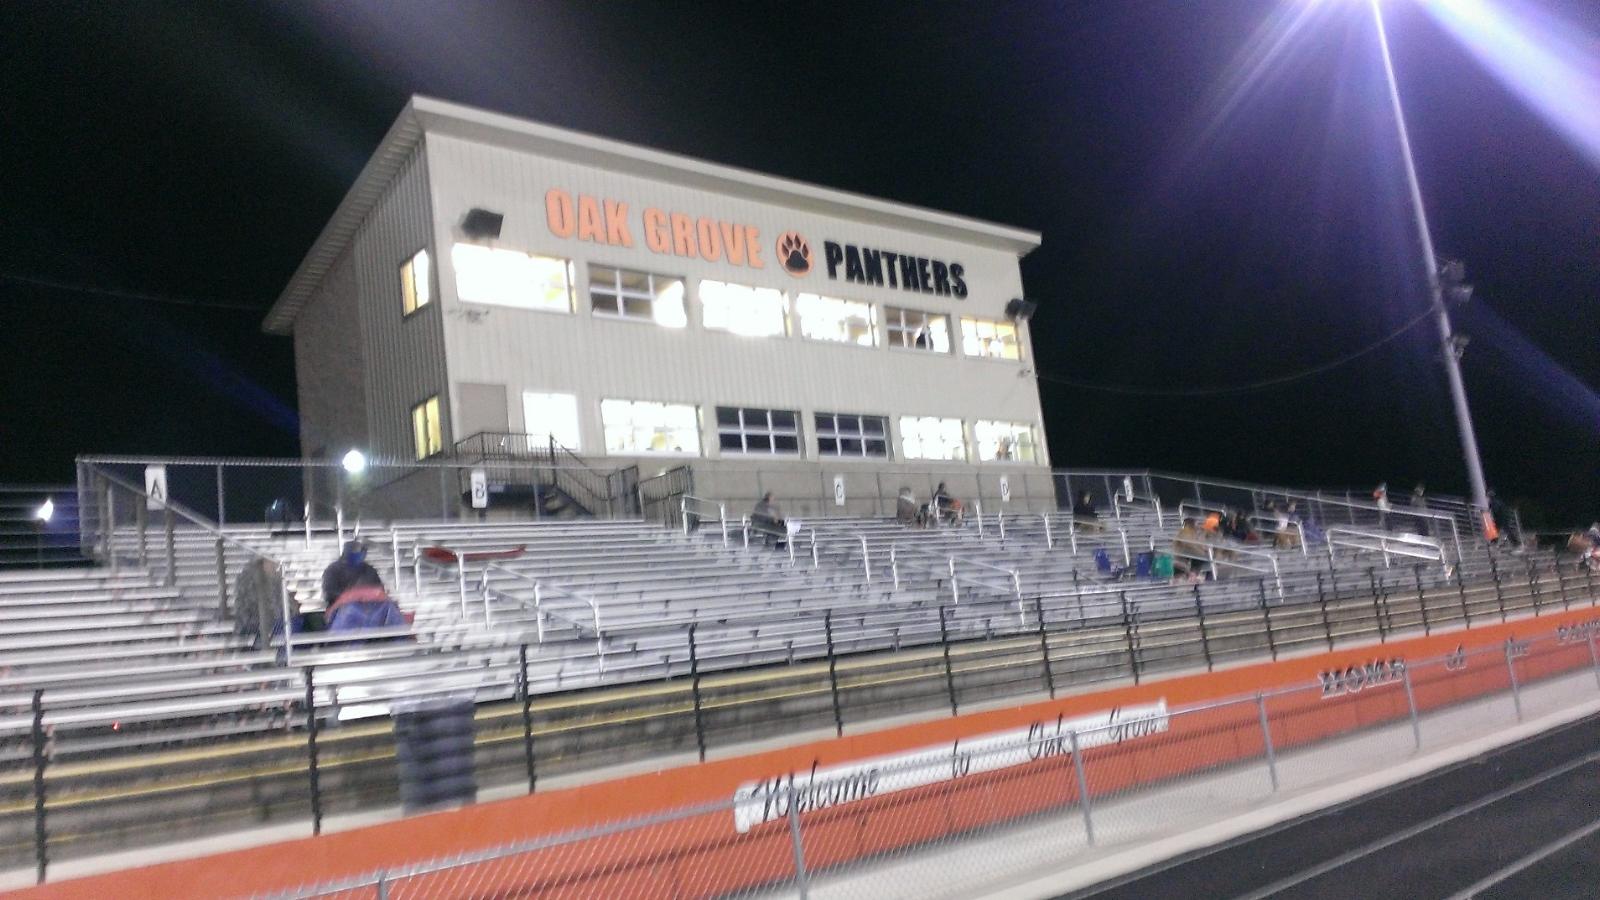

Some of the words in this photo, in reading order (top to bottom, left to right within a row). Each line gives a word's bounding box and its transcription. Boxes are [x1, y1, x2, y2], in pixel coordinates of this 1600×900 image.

[544, 188, 633, 248] OAK
[642, 206, 764, 270] GROVE
[823, 239, 969, 300] PANTHERS
[150, 478, 162, 499] A
[1027, 711, 1073, 761] Oak
